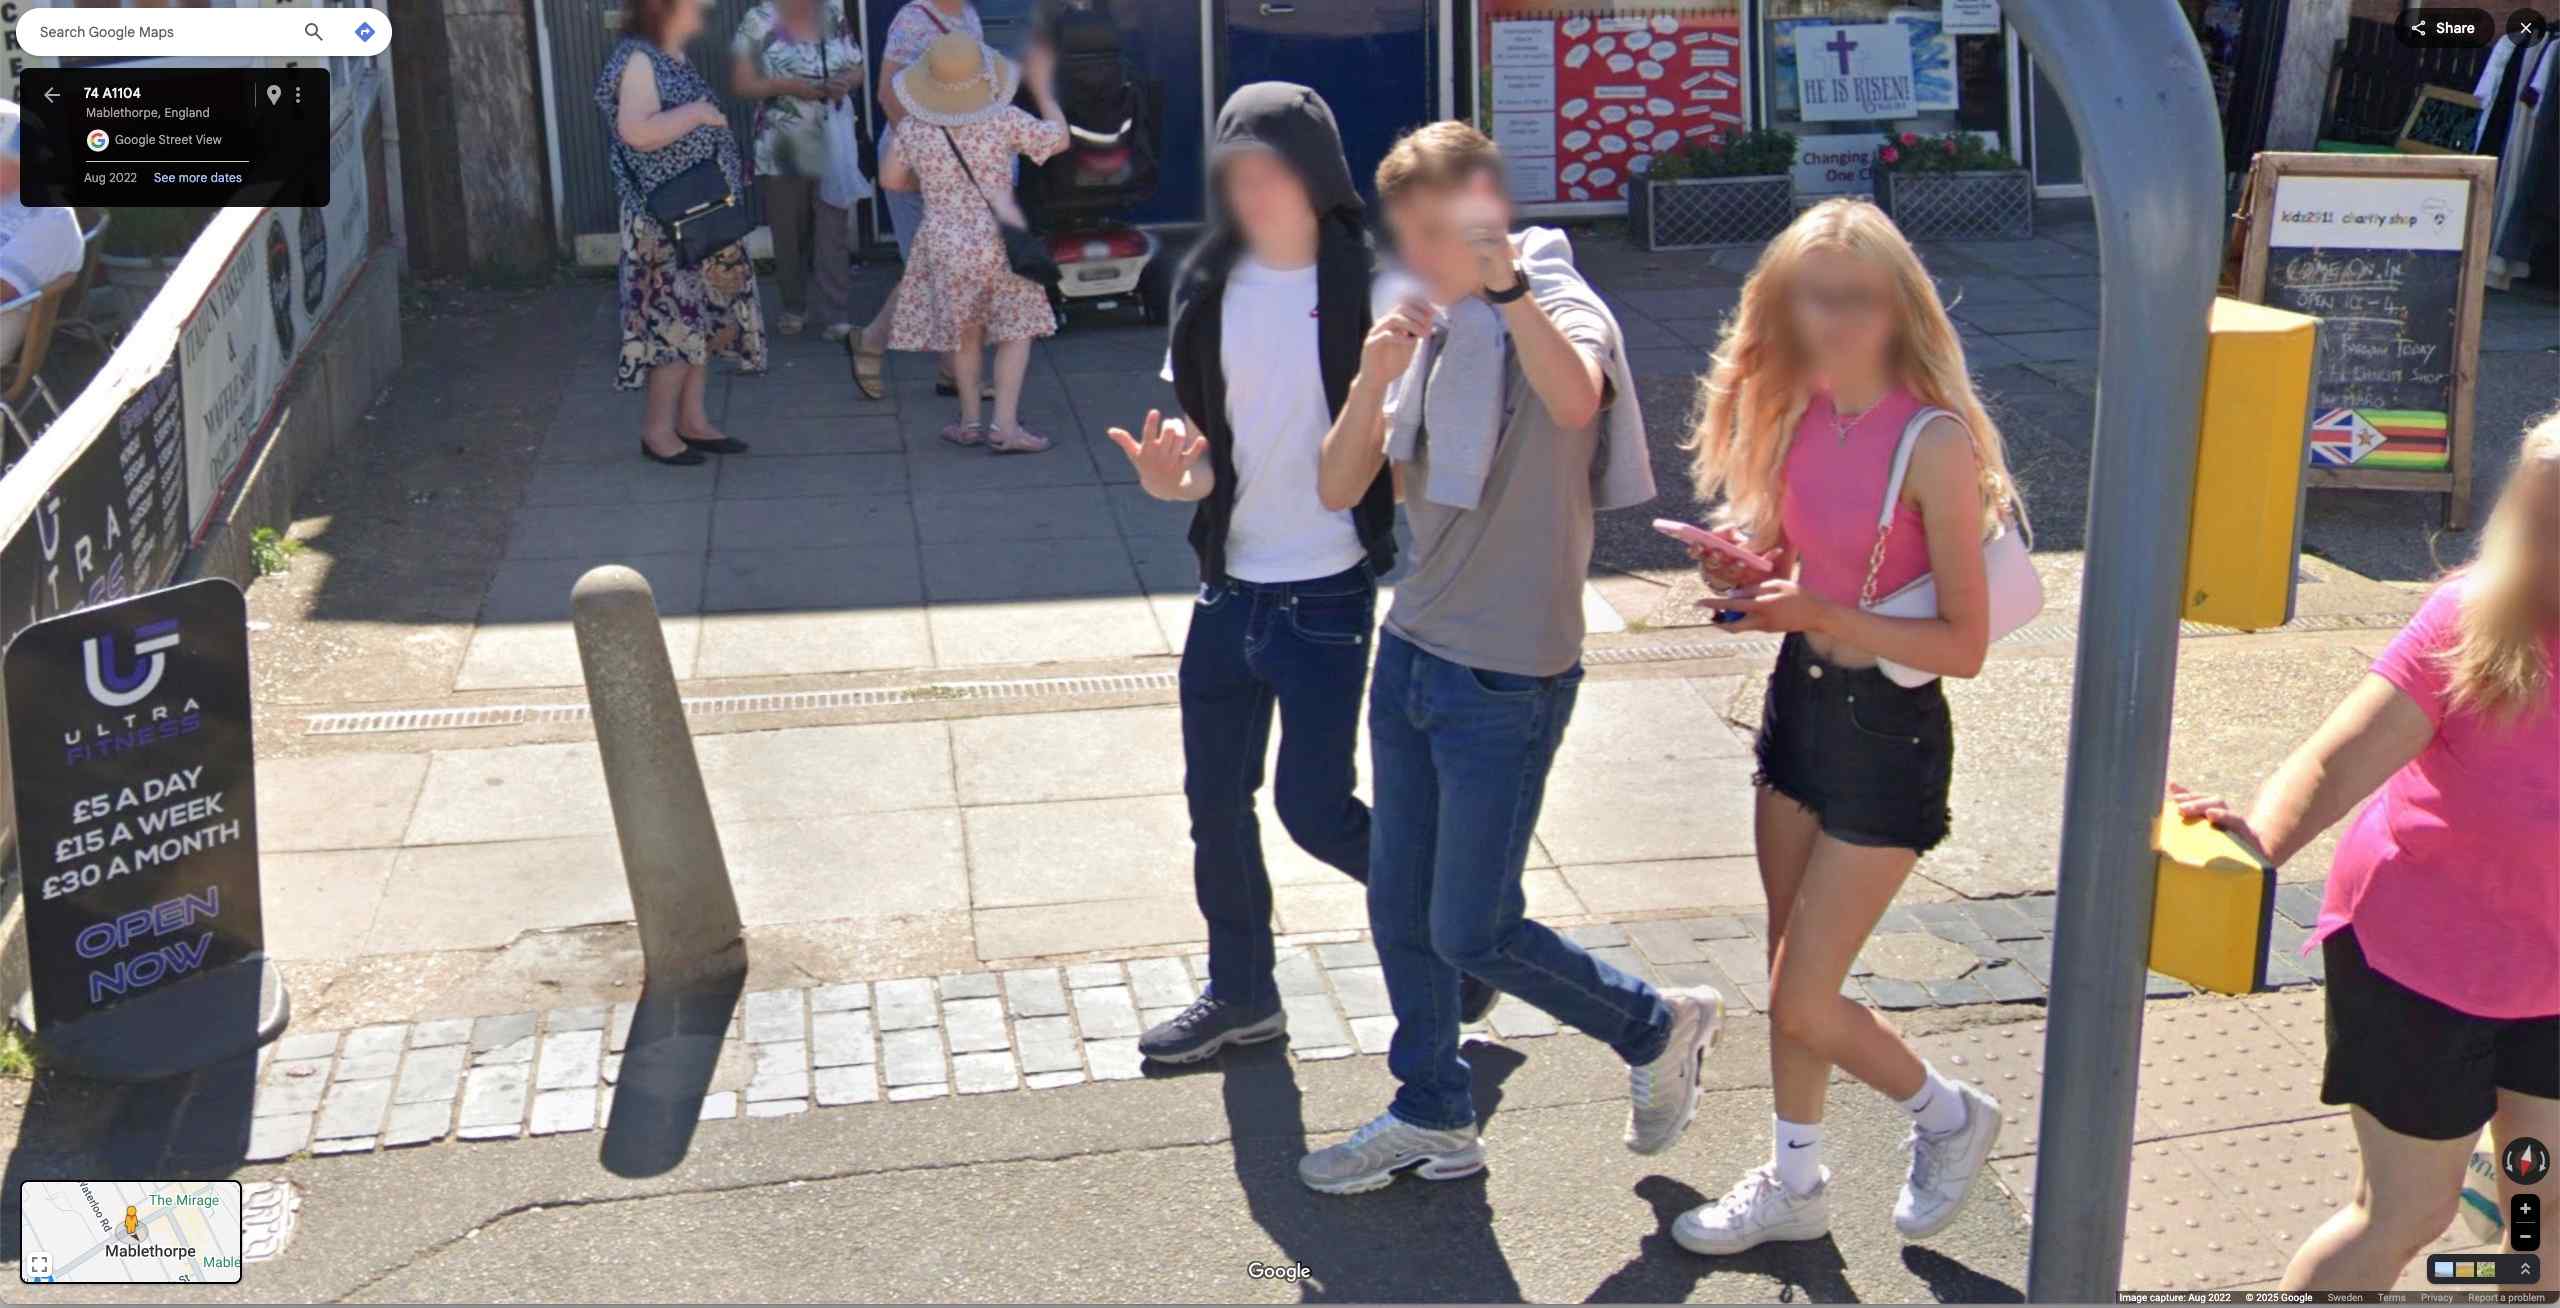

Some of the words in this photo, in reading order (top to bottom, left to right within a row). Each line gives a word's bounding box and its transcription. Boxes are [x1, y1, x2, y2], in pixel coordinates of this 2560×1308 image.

[1804, 79, 1825, 104] HE
[1832, 78, 1849, 103] IS
[1853, 76, 1911, 113] RISEN!
[1803, 151, 1868, 165] Changing
[1825, 169, 1856, 181] One
[65, 698, 200, 745] ULTRA
[66, 712, 201, 766] FITNESS
[73, 794, 110, 824] £5
[116, 788, 140, 811] A
[144, 766, 204, 802] DAY
[55, 829, 105, 863] £15
[110, 822, 133, 845] A
[137, 792, 225, 835] WEEK
[42, 865, 101, 900] £30
[107, 857, 130, 880] A
[135, 819, 241, 871] MONTH
[75, 885, 221, 958] OPEN
[89, 932, 214, 1003] NOW
